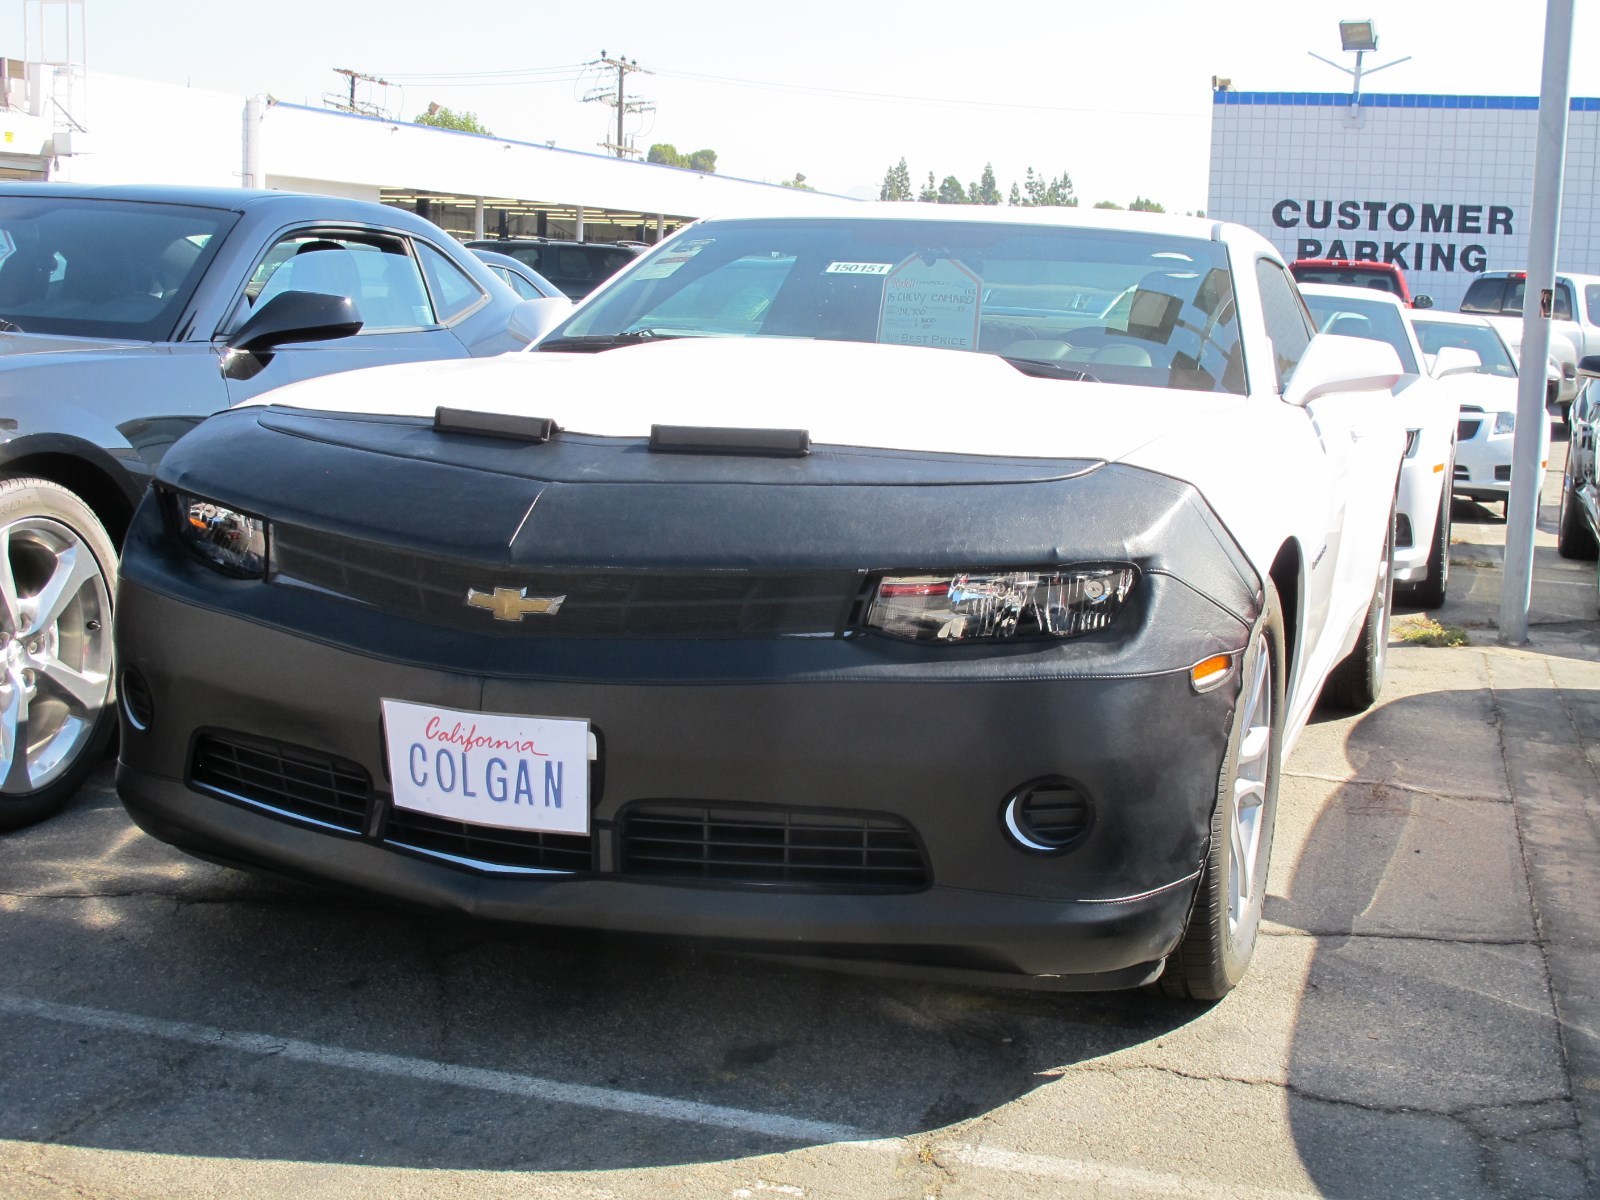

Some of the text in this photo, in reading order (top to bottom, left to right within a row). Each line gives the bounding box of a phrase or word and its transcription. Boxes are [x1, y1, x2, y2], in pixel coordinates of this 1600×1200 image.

[1271, 199, 1514, 235] CUSTOMER
[833, 263, 887, 273] 150151
[1297, 238, 1487, 273] PARKING
[896, 292, 927, 305] CHEVY
[931, 293, 975, 305] CAMARO
[901, 333, 929, 344] BEST
[931, 334, 967, 346] PRICE
[424, 716, 550, 757] California
[408, 742, 564, 809] COLGAN
